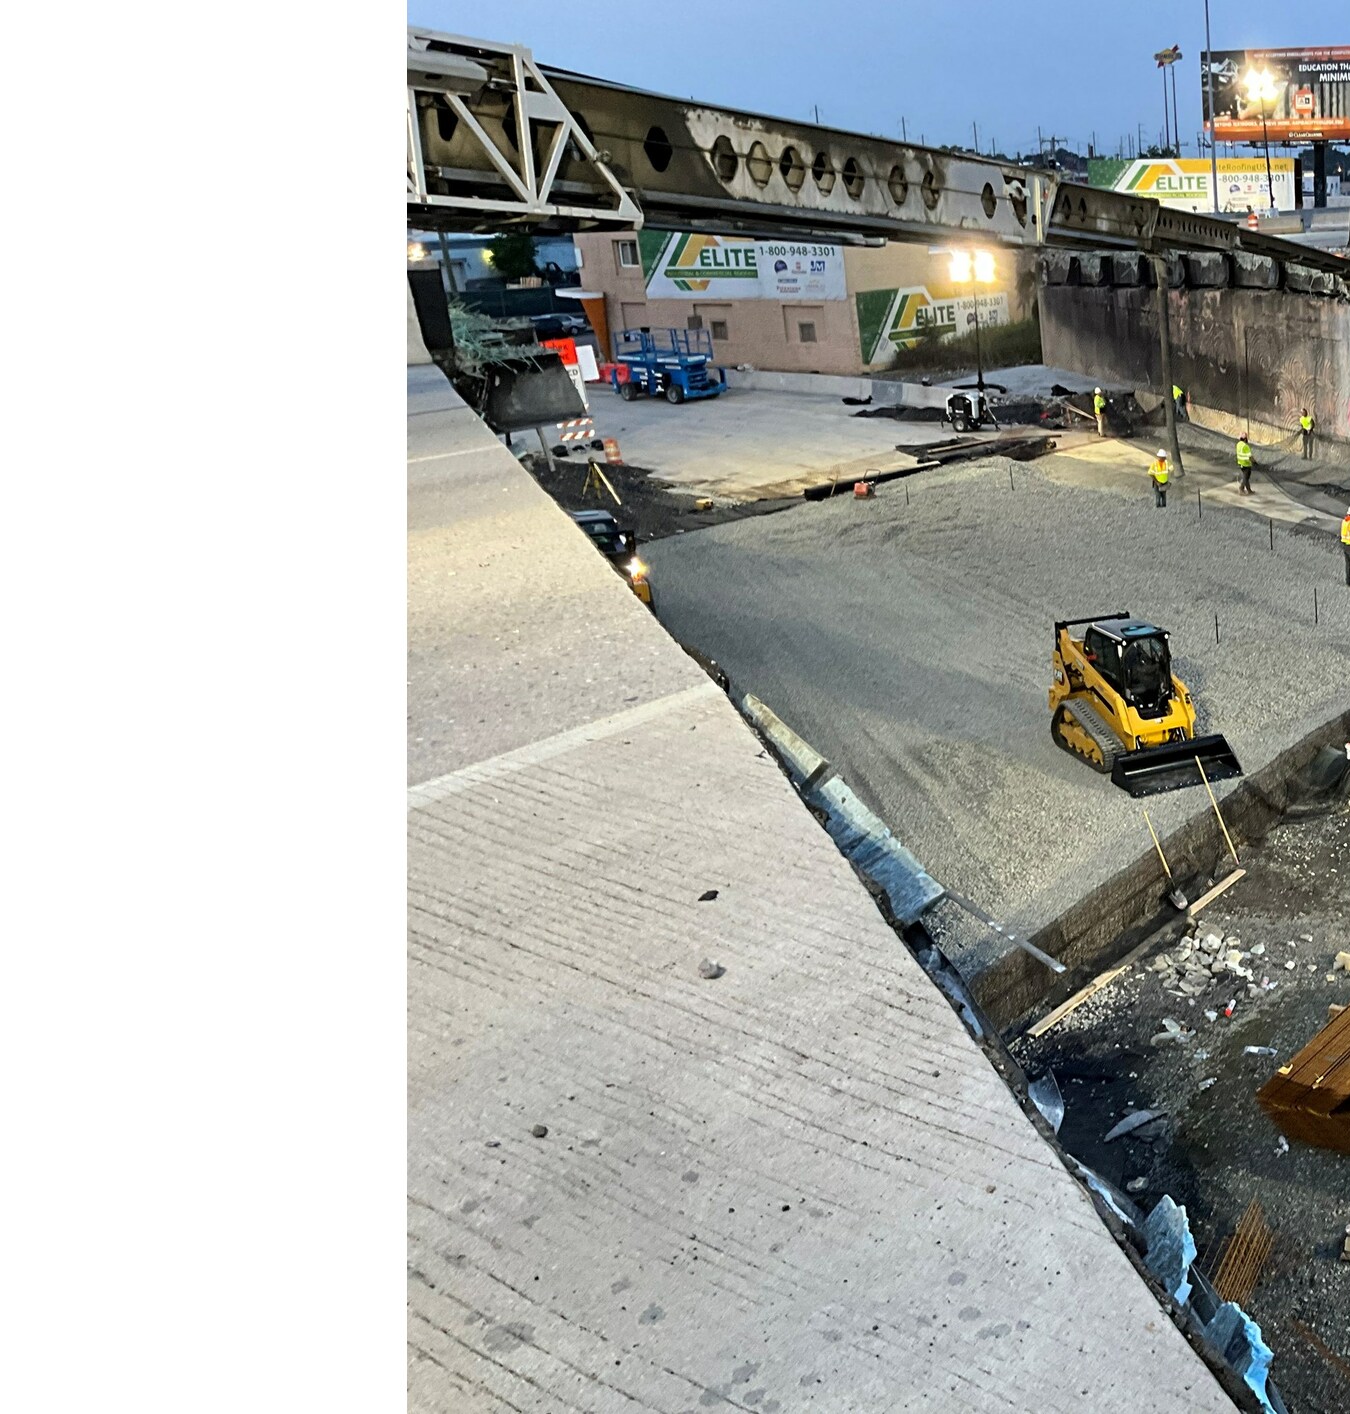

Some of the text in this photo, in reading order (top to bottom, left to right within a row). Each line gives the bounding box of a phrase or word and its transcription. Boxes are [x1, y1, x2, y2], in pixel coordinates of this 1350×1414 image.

[1298, 62, 1338, 72] EDUCATION
[1155, 176, 1208, 191] ELITE
[700, 248, 757, 267] ELITE
[759, 246, 836, 257] 1-800-948-3301
[915, 304, 956, 326] ELITE
